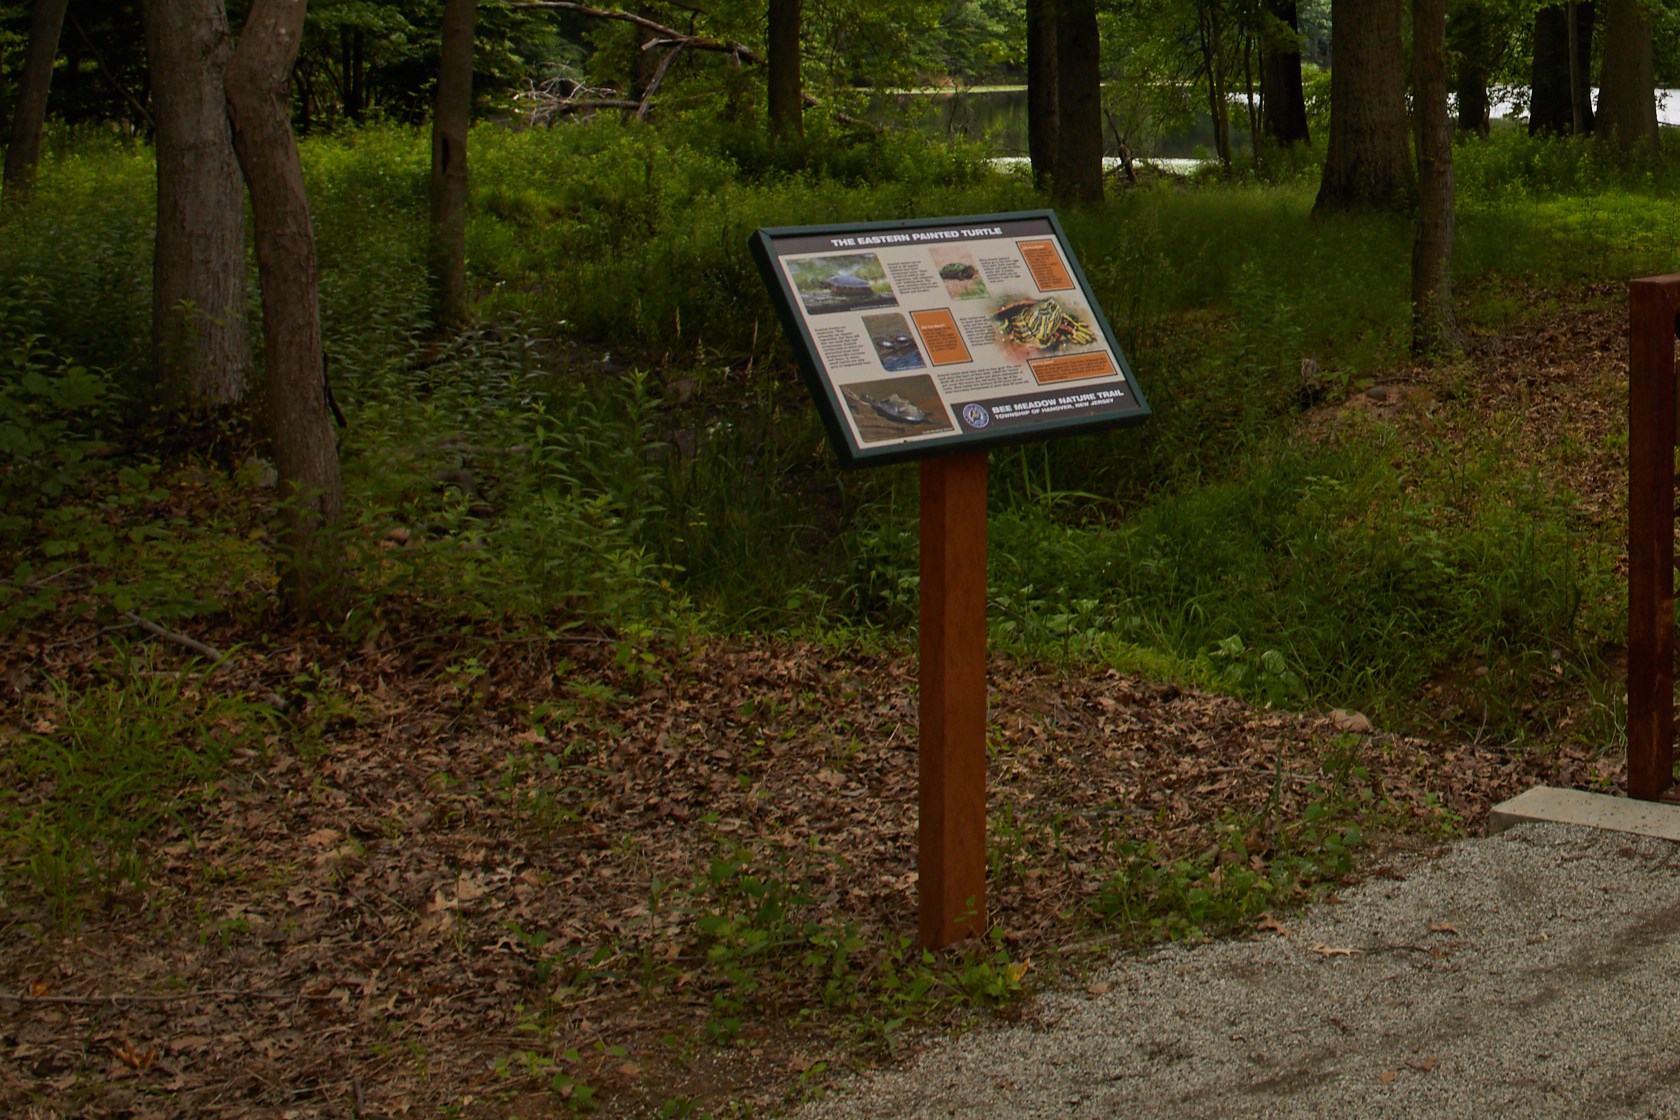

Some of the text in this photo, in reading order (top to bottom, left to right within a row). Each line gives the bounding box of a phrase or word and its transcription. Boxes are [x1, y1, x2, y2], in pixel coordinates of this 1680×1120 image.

[831, 227, 1002, 247] THE EASTERN PAINTED TURTLE
[992, 390, 1124, 414] BEE MEADOW NATURE TRAIL
[995, 410, 1029, 419] TOWNSHIP
[1090, 398, 1114, 406] JERSEY
